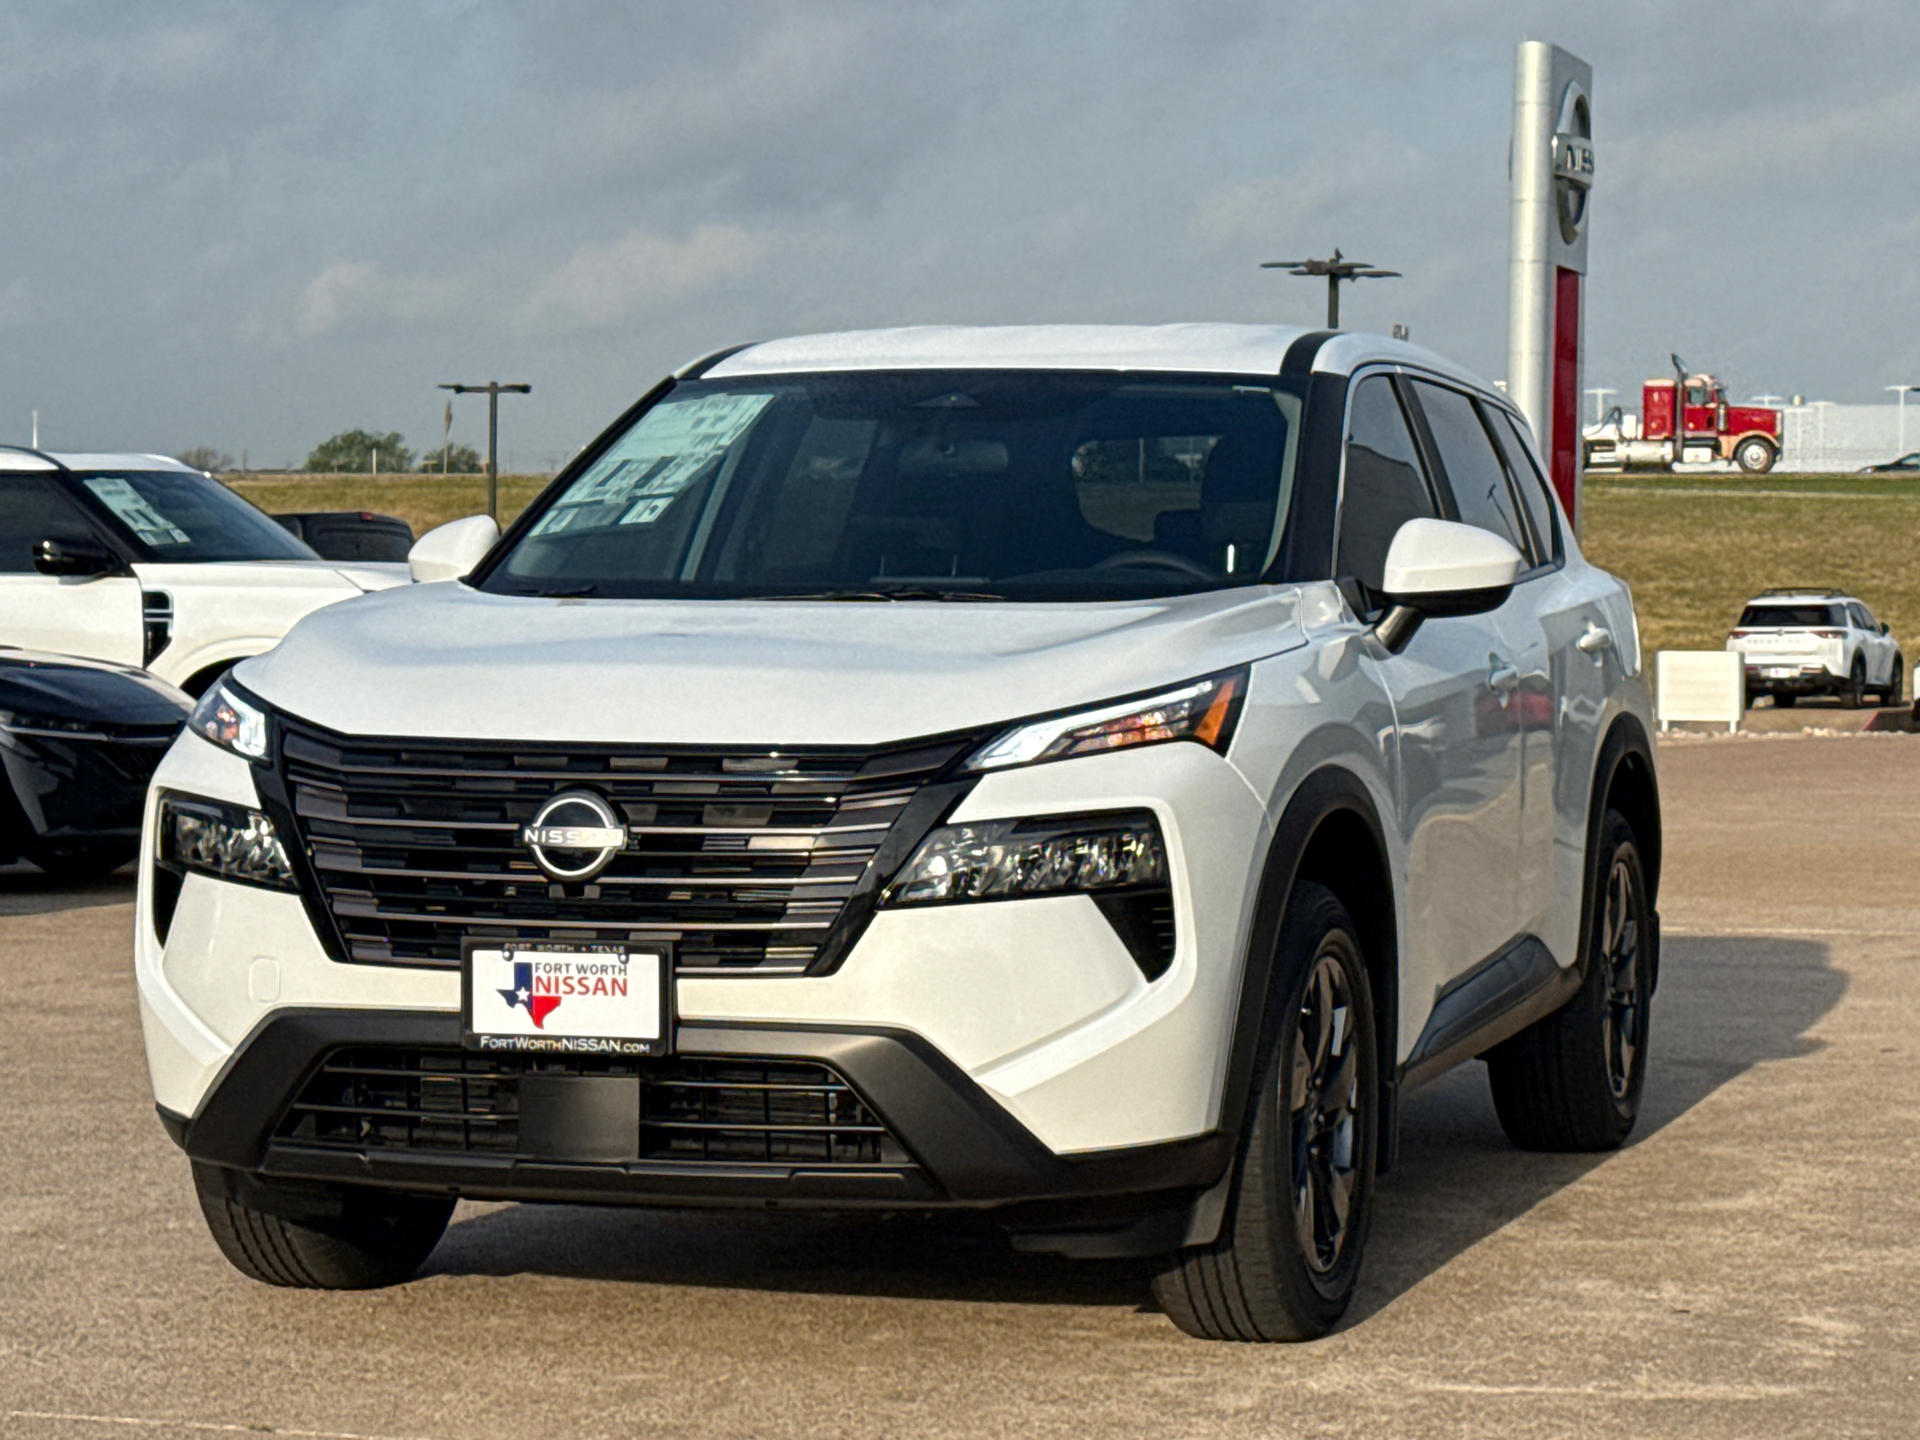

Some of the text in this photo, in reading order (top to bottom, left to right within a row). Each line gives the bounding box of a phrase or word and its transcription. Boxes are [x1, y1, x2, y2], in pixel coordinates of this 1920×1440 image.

[524, 828, 621, 846] NISS
[504, 943, 625, 954] FORT WORTH TEXAS
[535, 963, 627, 976] FORT WORTH
[535, 976, 627, 997] NISSAN
